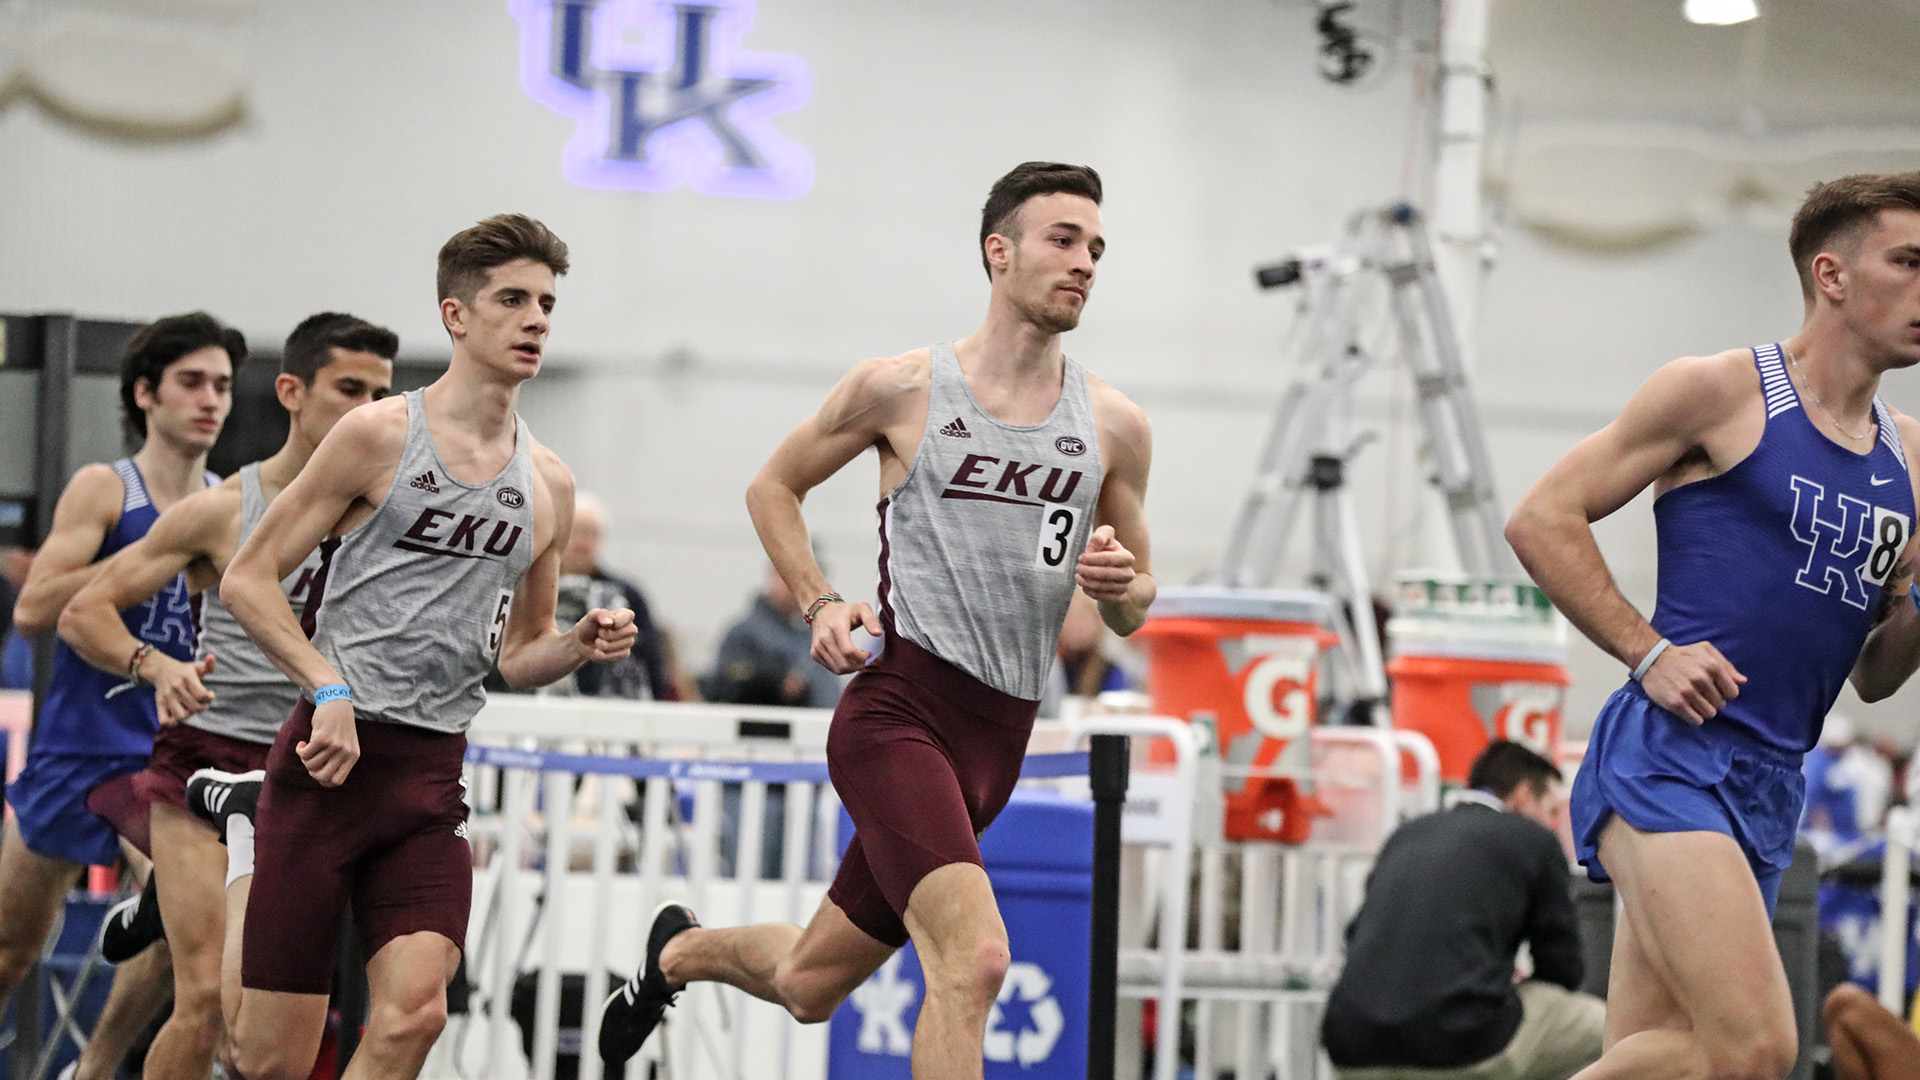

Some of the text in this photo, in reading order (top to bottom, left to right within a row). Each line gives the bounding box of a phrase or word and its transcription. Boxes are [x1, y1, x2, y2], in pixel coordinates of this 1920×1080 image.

[541, 0, 784, 169] UK
[940, 428, 972, 439] adidas
[1060, 441, 1080, 452] OVC
[410, 480, 440, 494] adidas
[501, 491, 519, 505] OVC
[950, 453, 1083, 503] EKU
[403, 507, 523, 557] EKU
[1043, 509, 1074, 567] 3
[1789, 475, 1873, 611] UK
[1870, 515, 1903, 580] 8
[490, 595, 510, 651] 5
[1244, 655, 1312, 738] G
[1505, 699, 1558, 752] G
